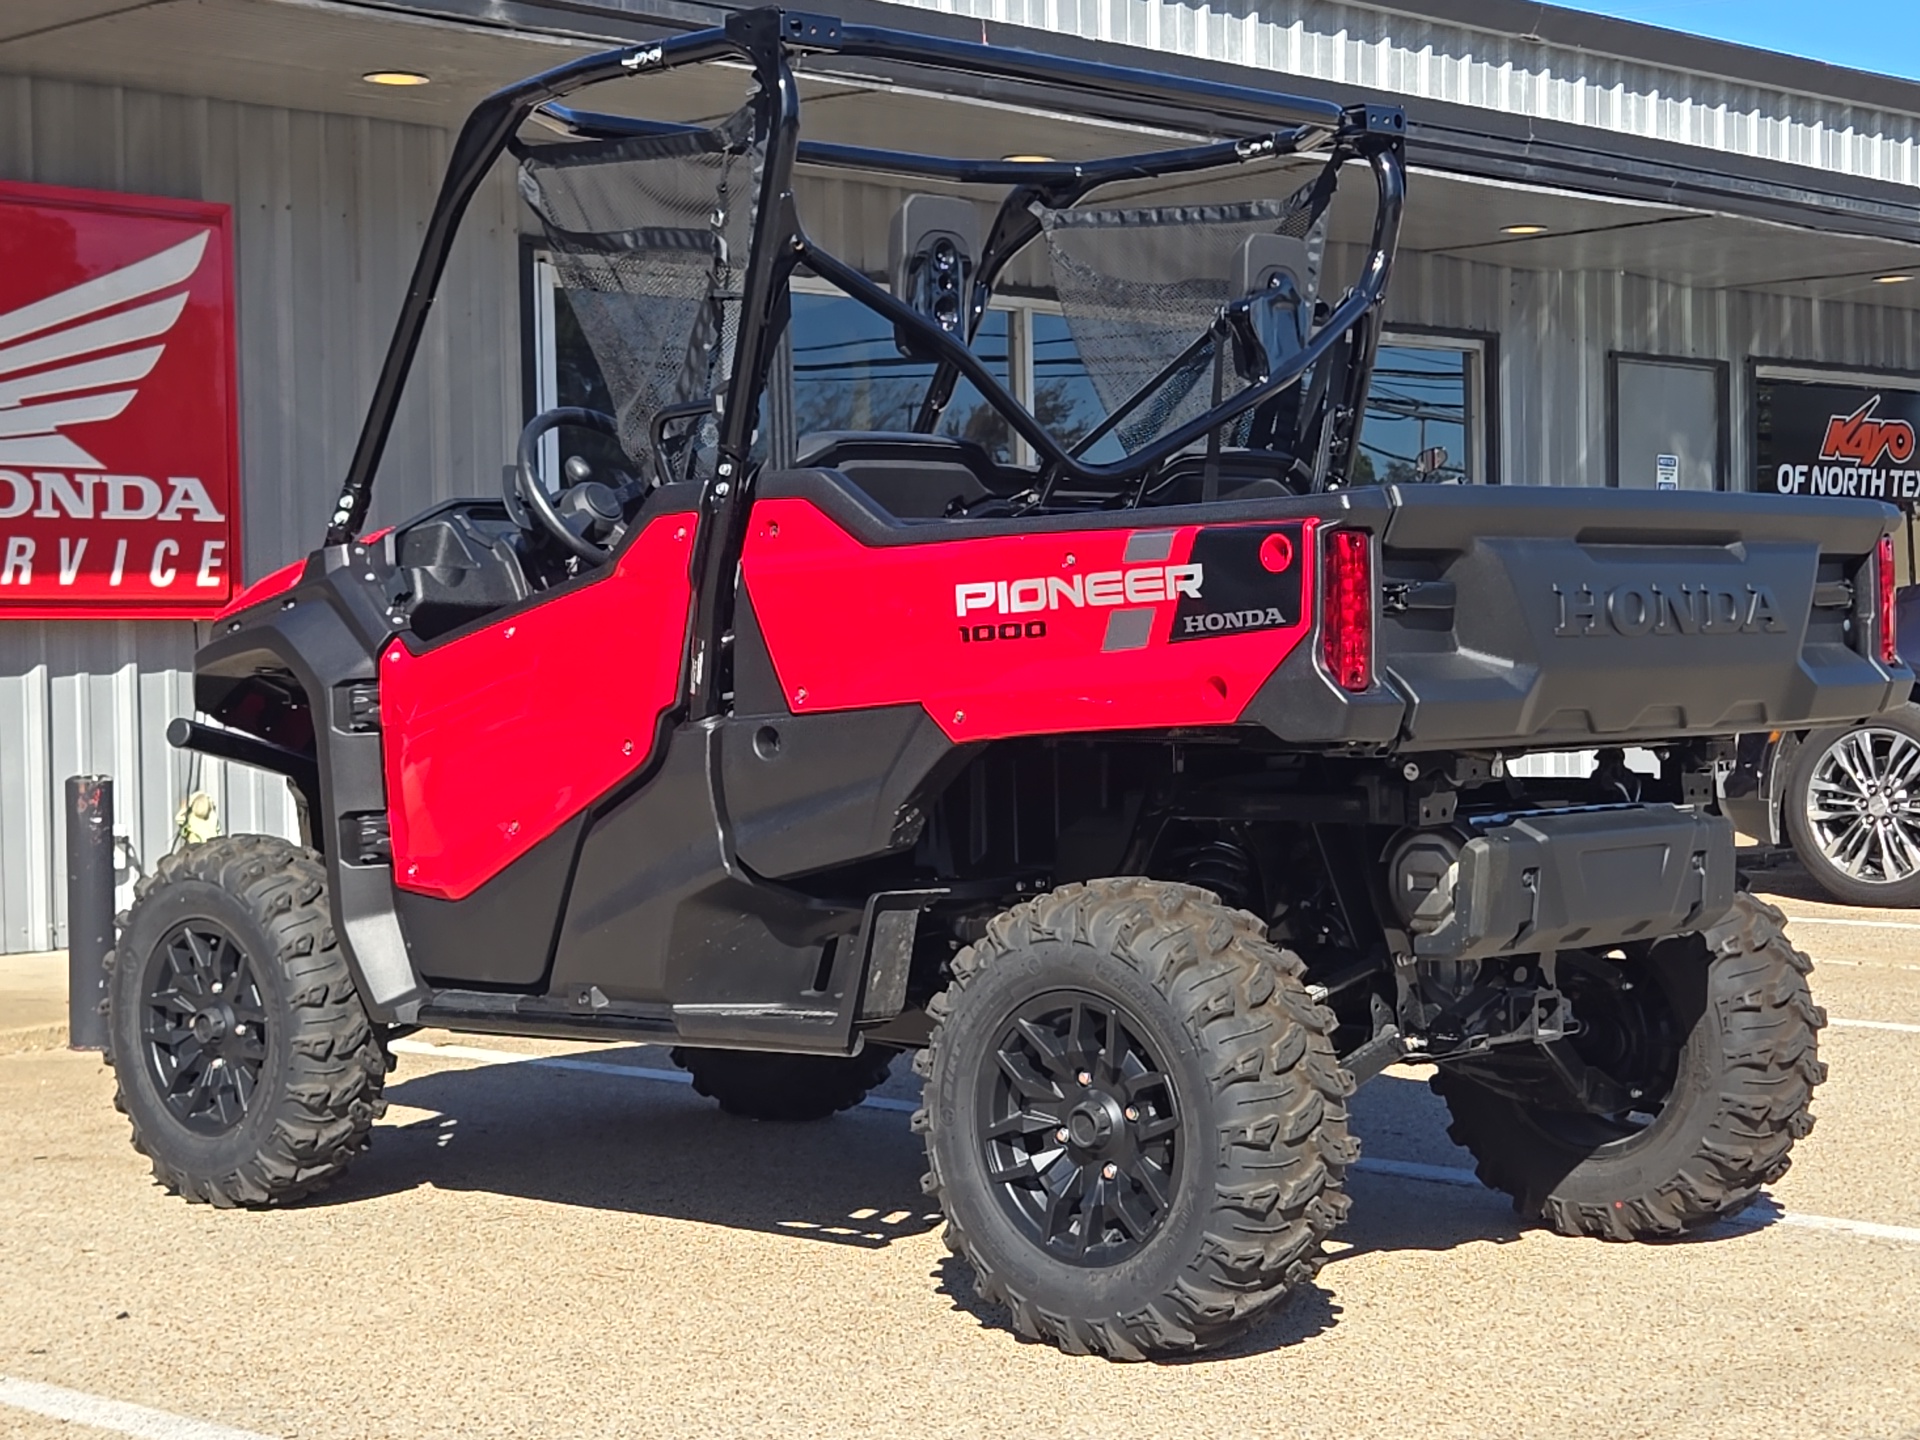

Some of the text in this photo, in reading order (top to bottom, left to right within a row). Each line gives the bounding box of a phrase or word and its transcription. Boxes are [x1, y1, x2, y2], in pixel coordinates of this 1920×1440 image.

[1819, 394, 1916, 466] KAYO
[0, 470, 225, 522] ONDA
[1777, 463, 1920, 497] OF NORTH TEX
[0, 536, 225, 588] RVICE
[955, 563, 1203, 617] PIONEER
[1552, 582, 1788, 638] HONDA
[958, 620, 1047, 643] 1000
[1183, 607, 1286, 633] HONDA
